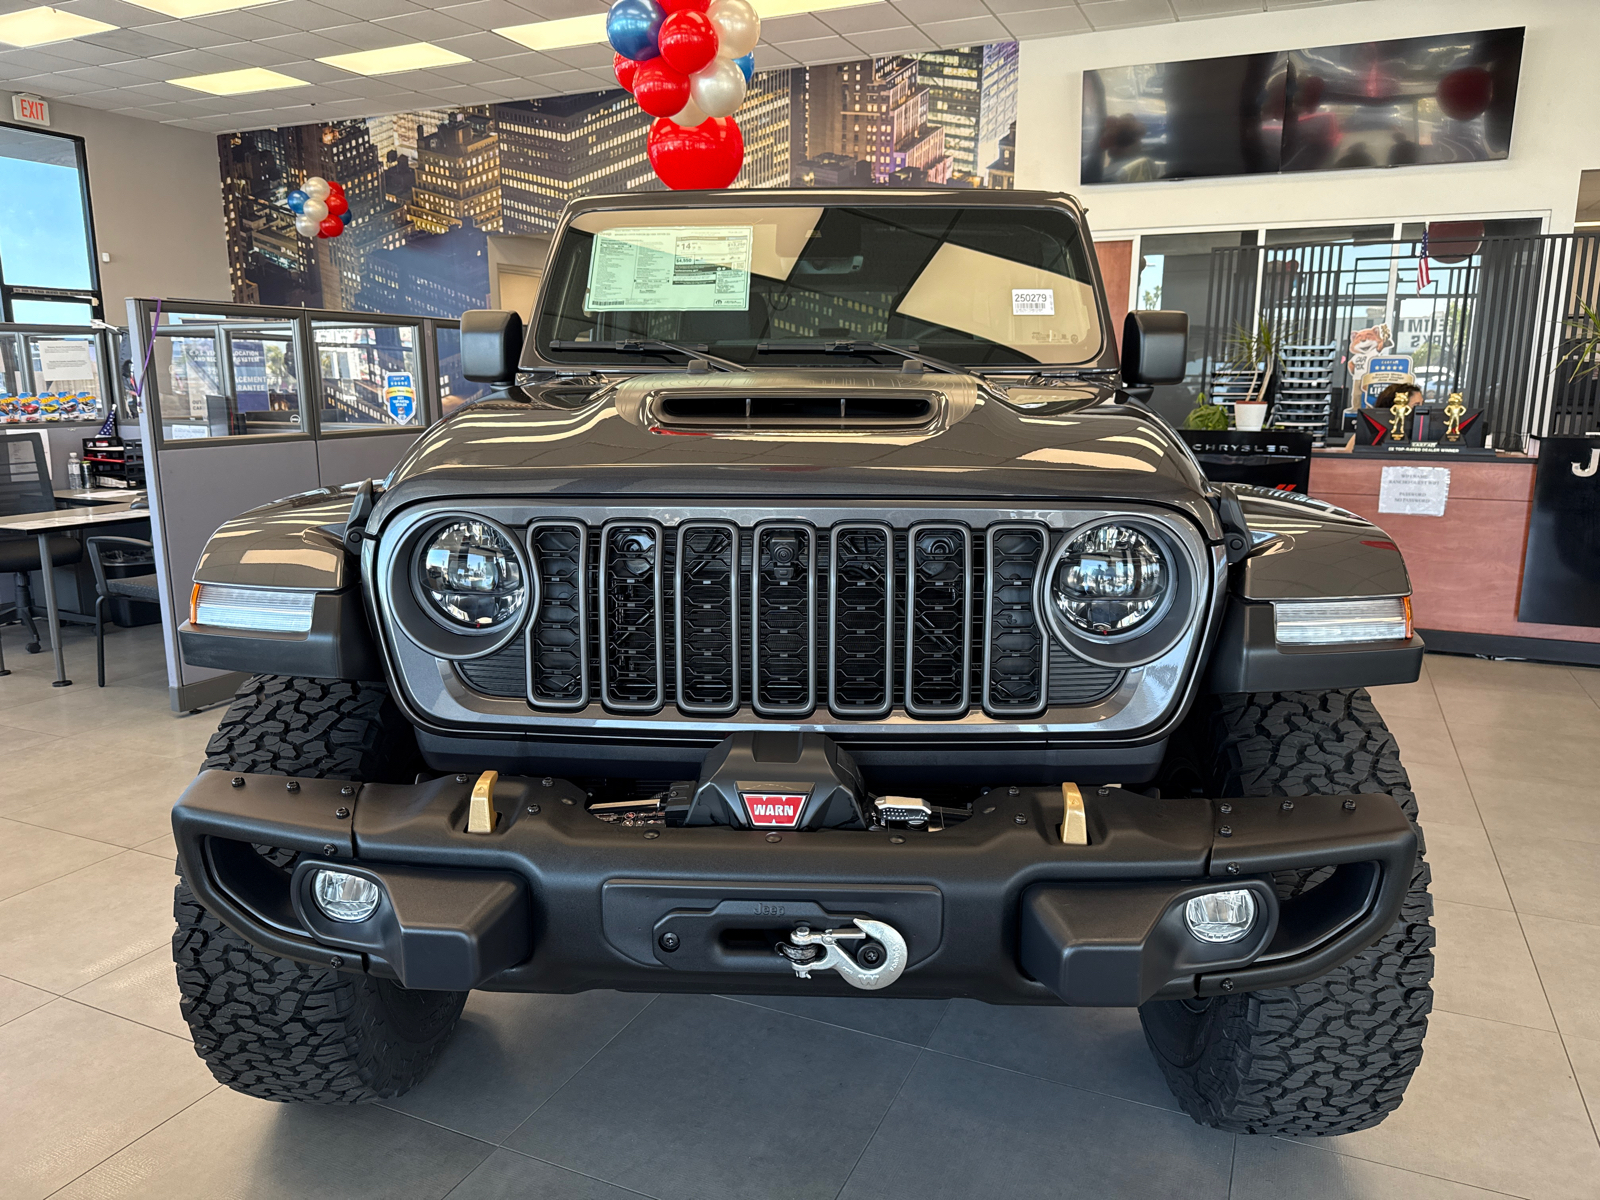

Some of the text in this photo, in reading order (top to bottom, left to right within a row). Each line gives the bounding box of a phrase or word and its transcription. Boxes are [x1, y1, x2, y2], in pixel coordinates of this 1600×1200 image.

[20, 98, 45, 121] EXIT
[1014, 293, 1047, 302] 250279
[1192, 443, 1290, 453] CHRYSLER
[753, 804, 794, 816] WARN
[753, 902, 786, 918] Jeep
